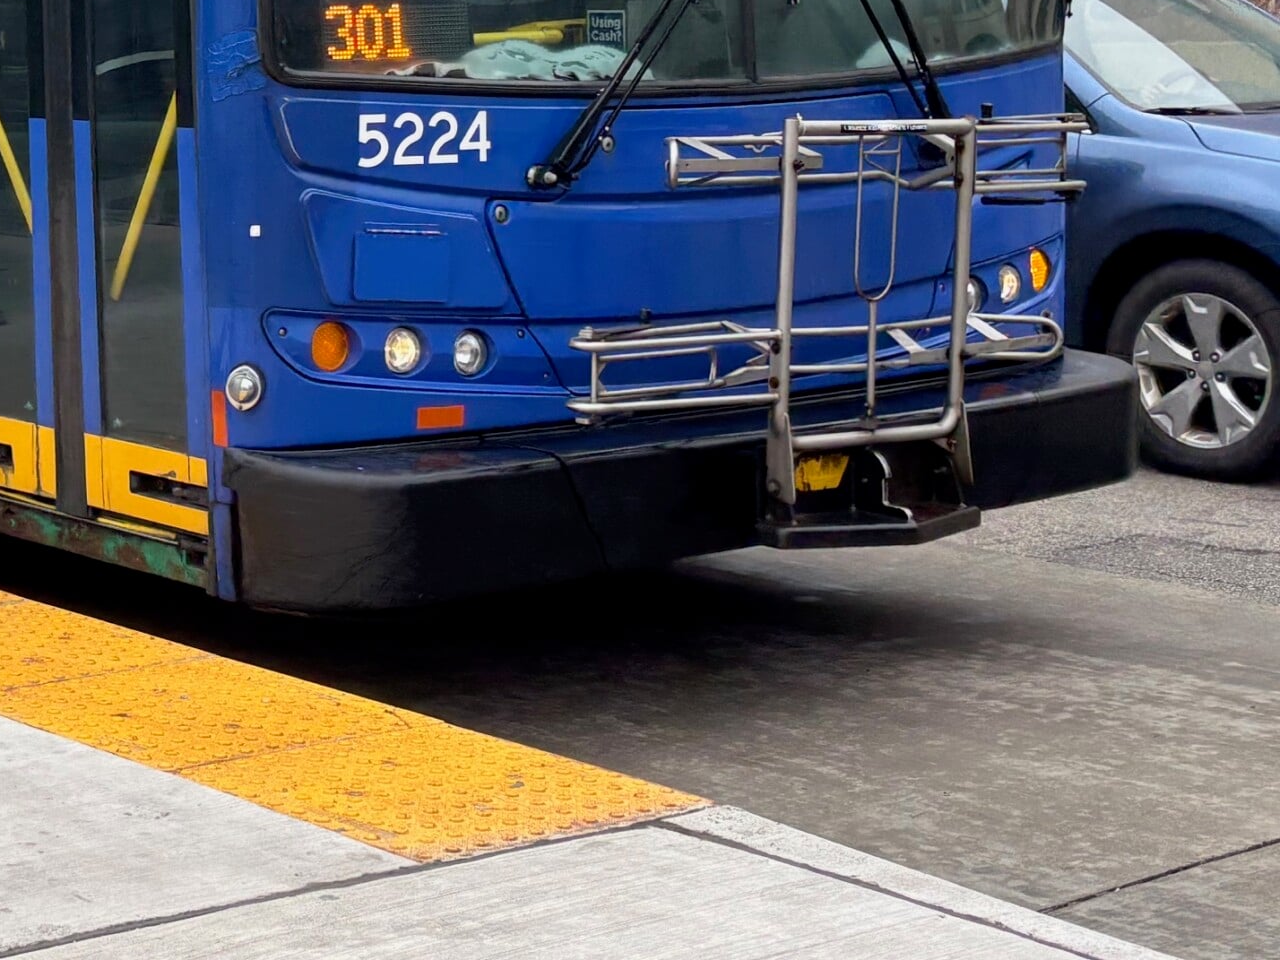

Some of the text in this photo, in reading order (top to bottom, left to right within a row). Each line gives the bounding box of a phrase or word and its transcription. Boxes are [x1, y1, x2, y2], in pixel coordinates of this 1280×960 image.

[325, 3, 412, 61] 301
[591, 15, 622, 42] Using Cash?
[357, 110, 492, 168] 5224
